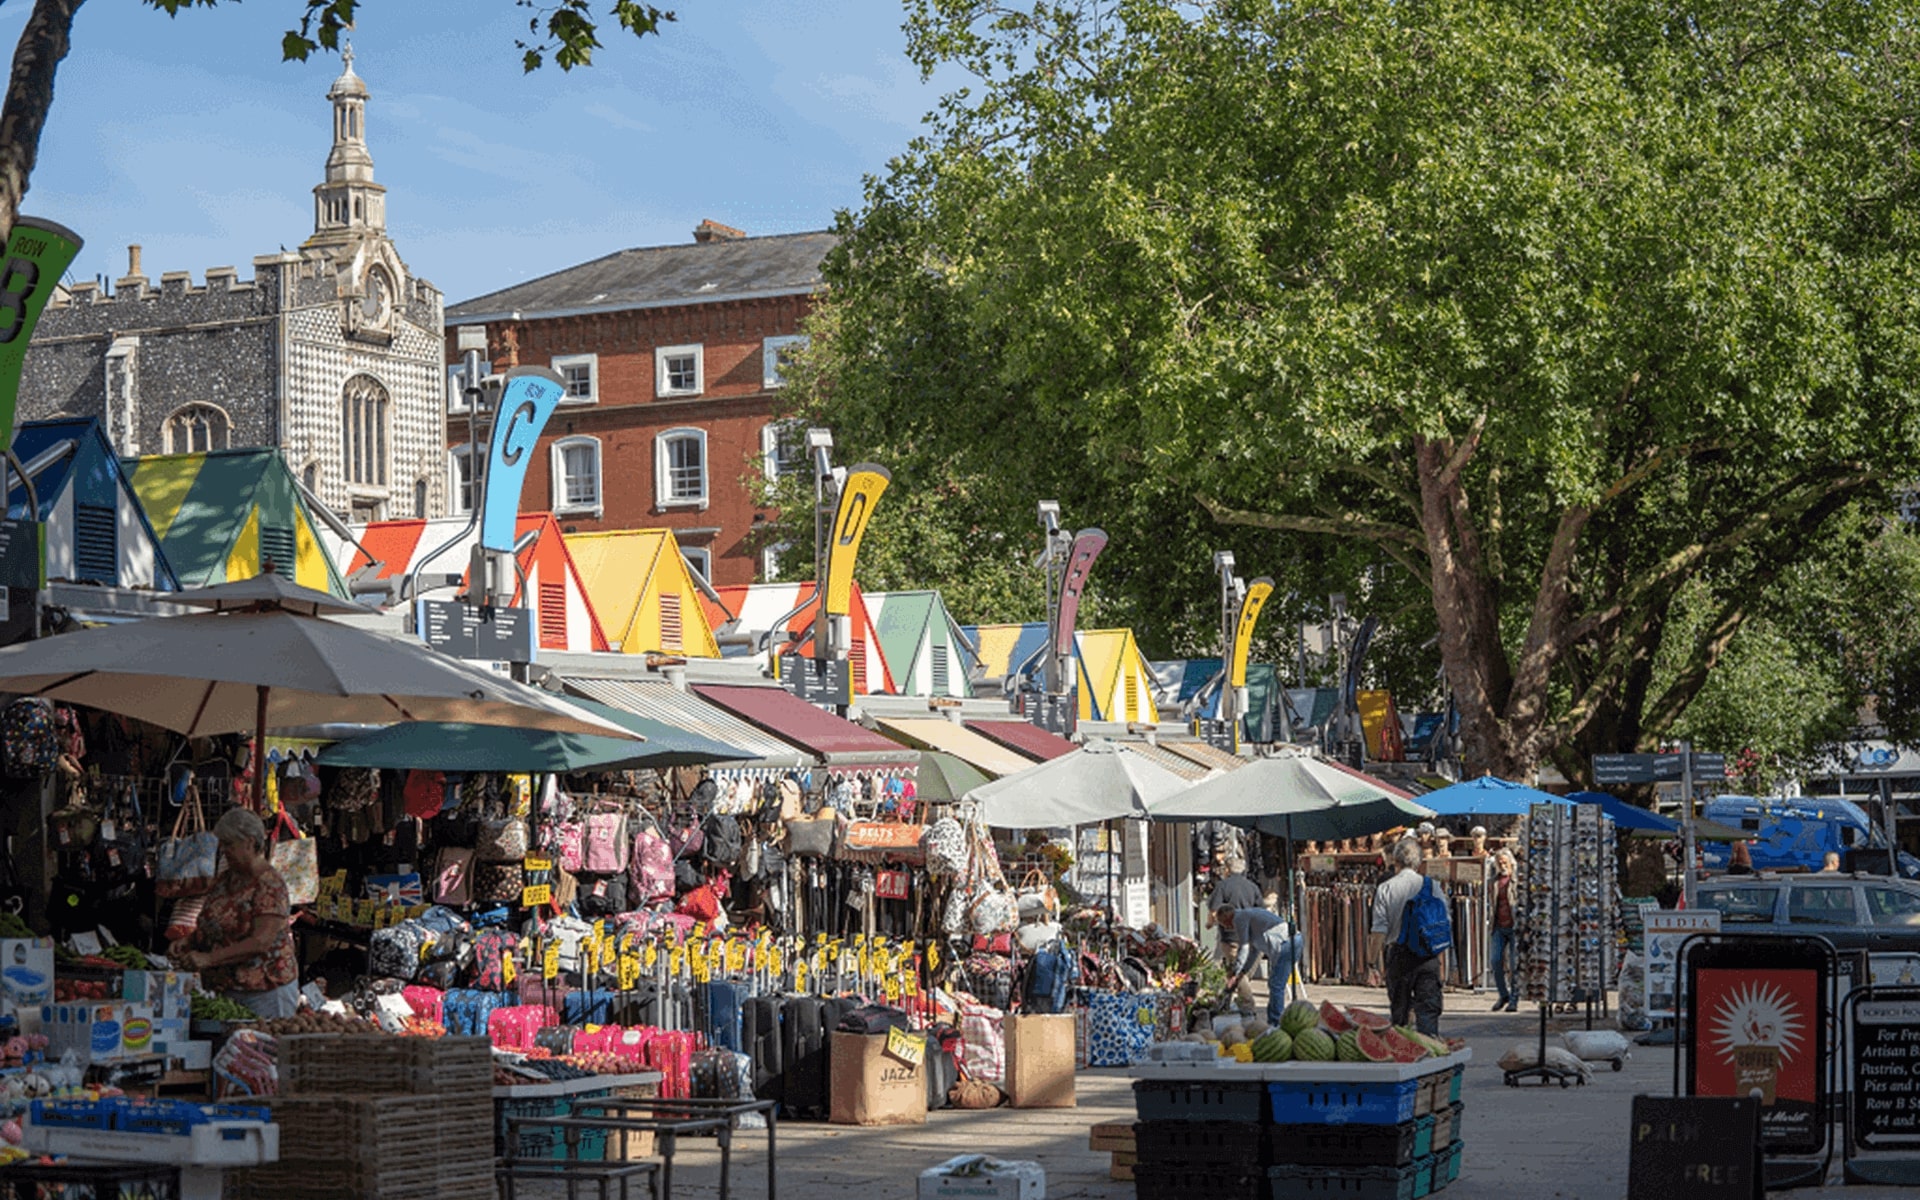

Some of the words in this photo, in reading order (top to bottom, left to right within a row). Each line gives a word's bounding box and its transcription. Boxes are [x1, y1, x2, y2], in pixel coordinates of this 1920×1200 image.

[13, 236, 48, 257] ROW
[0, 256, 39, 343] B
[502, 400, 536, 467] C
[840, 492, 867, 546] D
[859, 828, 893, 842] BELTS
[1877, 1028, 1898, 1041] For
[1862, 1044, 1906, 1057] Artisan
[1909, 1044, 1920, 1057] B
[1737, 1051, 1775, 1067] COFFEE
[880, 1067, 915, 1082] JAZZ
[1860, 1062, 1908, 1076] Pastries,
[1864, 1079, 1888, 1092] Pies
[1890, 1078, 1913, 1092] and
[1866, 1097, 1893, 1110] Row
[1895, 1097, 1906, 1110] B
[1873, 1114, 1890, 1127] 44
[1892, 1113, 1916, 1127] and
[1684, 1163, 1740, 1185] FREE
